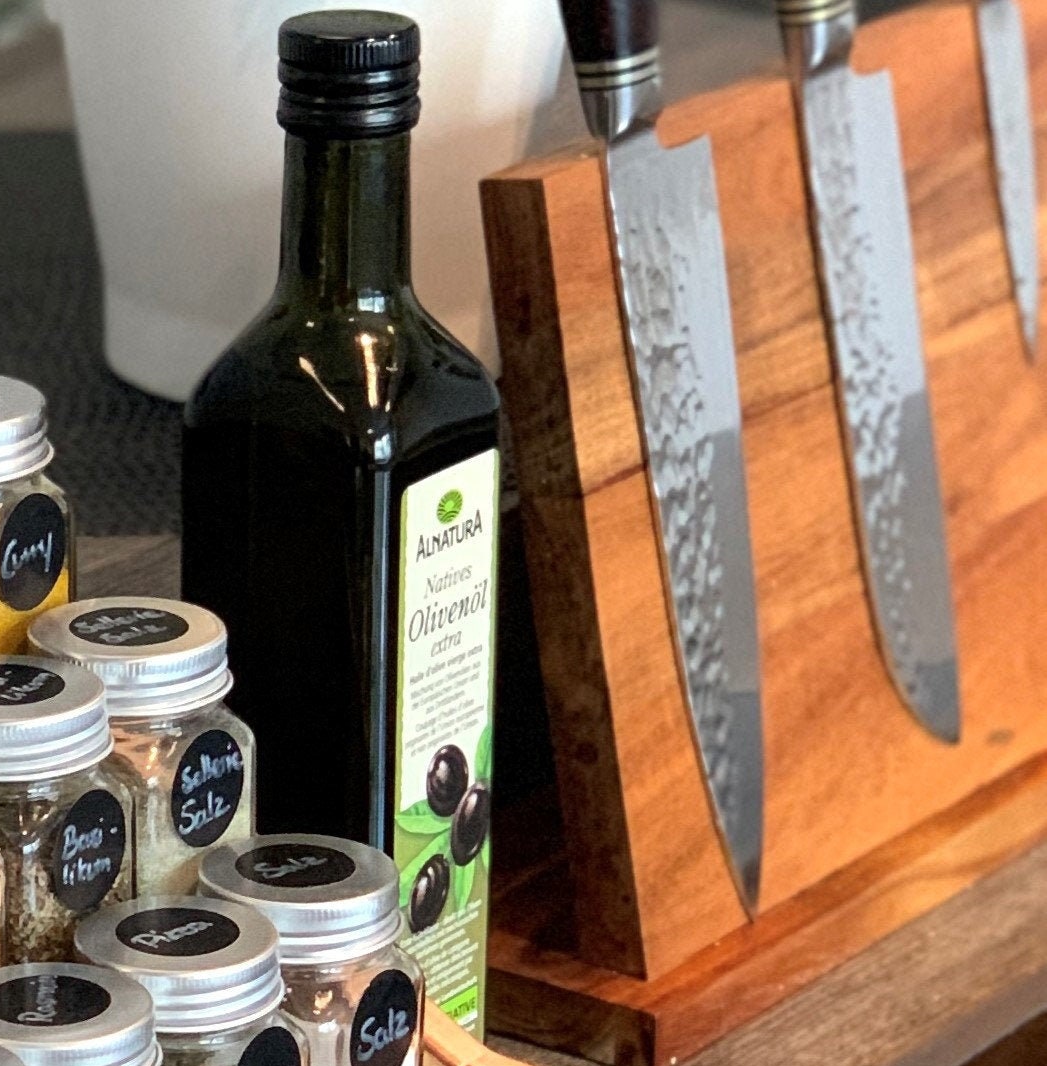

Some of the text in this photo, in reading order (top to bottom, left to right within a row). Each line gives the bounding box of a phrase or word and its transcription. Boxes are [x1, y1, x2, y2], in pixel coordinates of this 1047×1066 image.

[415, 508, 483, 563] ALNATURA
[423, 564, 473, 599] Natives
[408, 578, 488, 642] Olivenöl
[430, 630, 462, 658] extra
[178, 791, 231, 836] Salz
[356, 1007, 410, 1062] Salz
